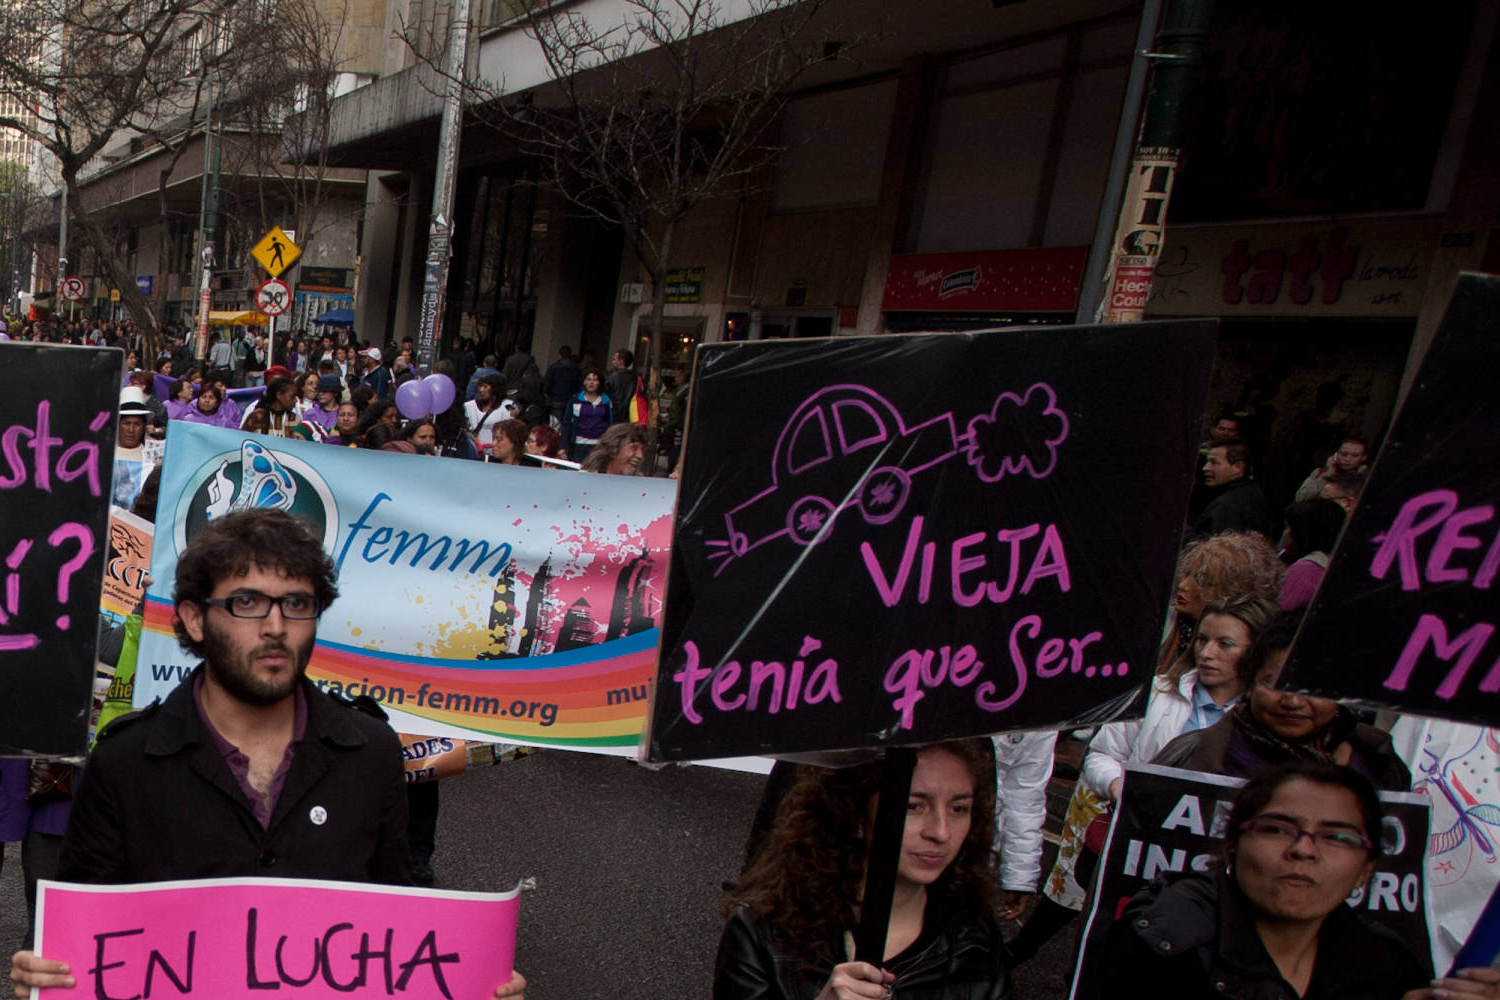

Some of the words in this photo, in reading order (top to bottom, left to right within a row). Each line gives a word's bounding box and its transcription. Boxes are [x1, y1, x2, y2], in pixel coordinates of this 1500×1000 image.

[335, 491, 512, 579] femm
[861, 515, 1071, 608] VIEJA
[1369, 488, 1500, 591] RE
[317, 677, 559, 727] racion-femm.org
[674, 635, 842, 725] tenía
[884, 645, 984, 729] que
[245, 907, 461, 1000] LUCHA
